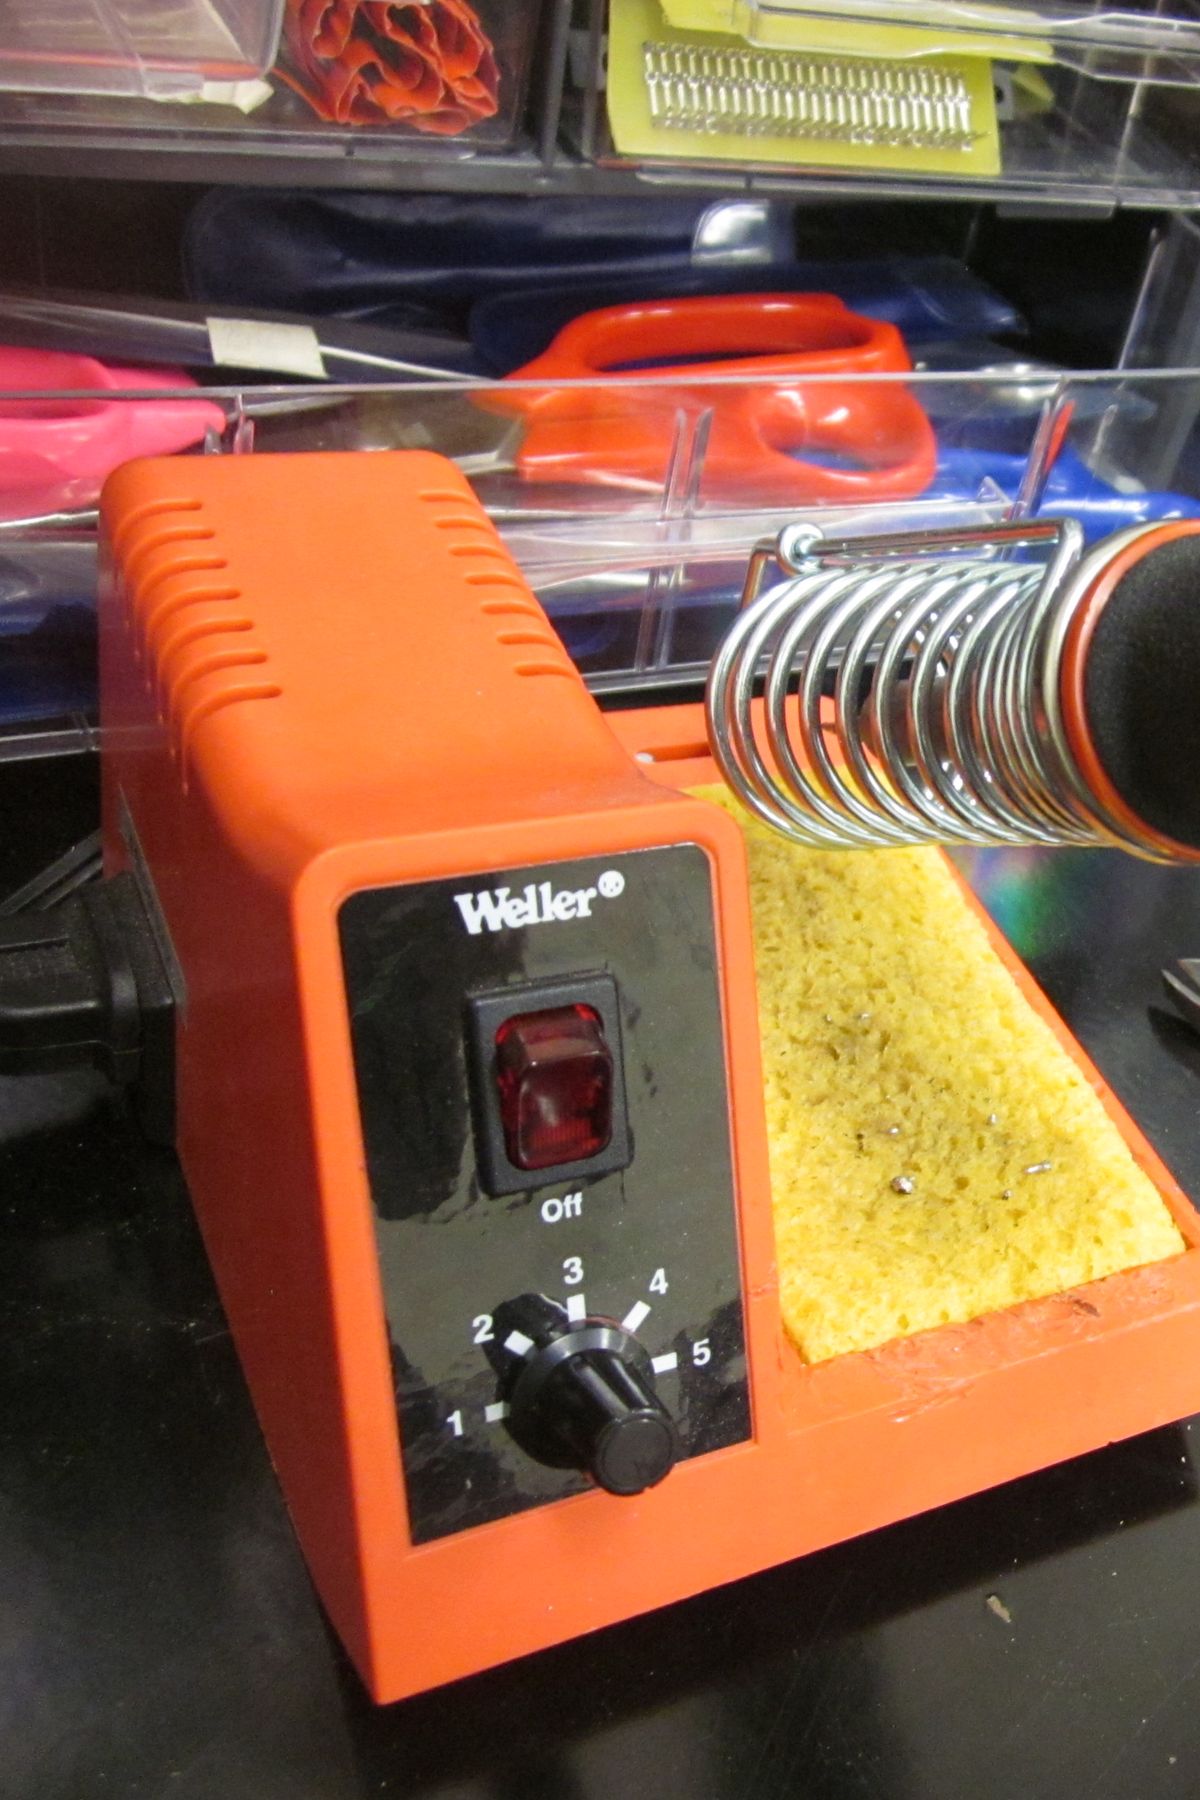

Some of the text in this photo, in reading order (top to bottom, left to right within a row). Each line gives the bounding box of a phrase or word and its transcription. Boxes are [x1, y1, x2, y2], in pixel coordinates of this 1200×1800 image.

[541, 1192, 583, 1223] Off
[562, 1257, 584, 1285] 3
[649, 1268, 669, 1294] 4
[472, 1314, 494, 1344] 2
[692, 1338, 712, 1366] 5
[446, 1410, 463, 1436] 1
